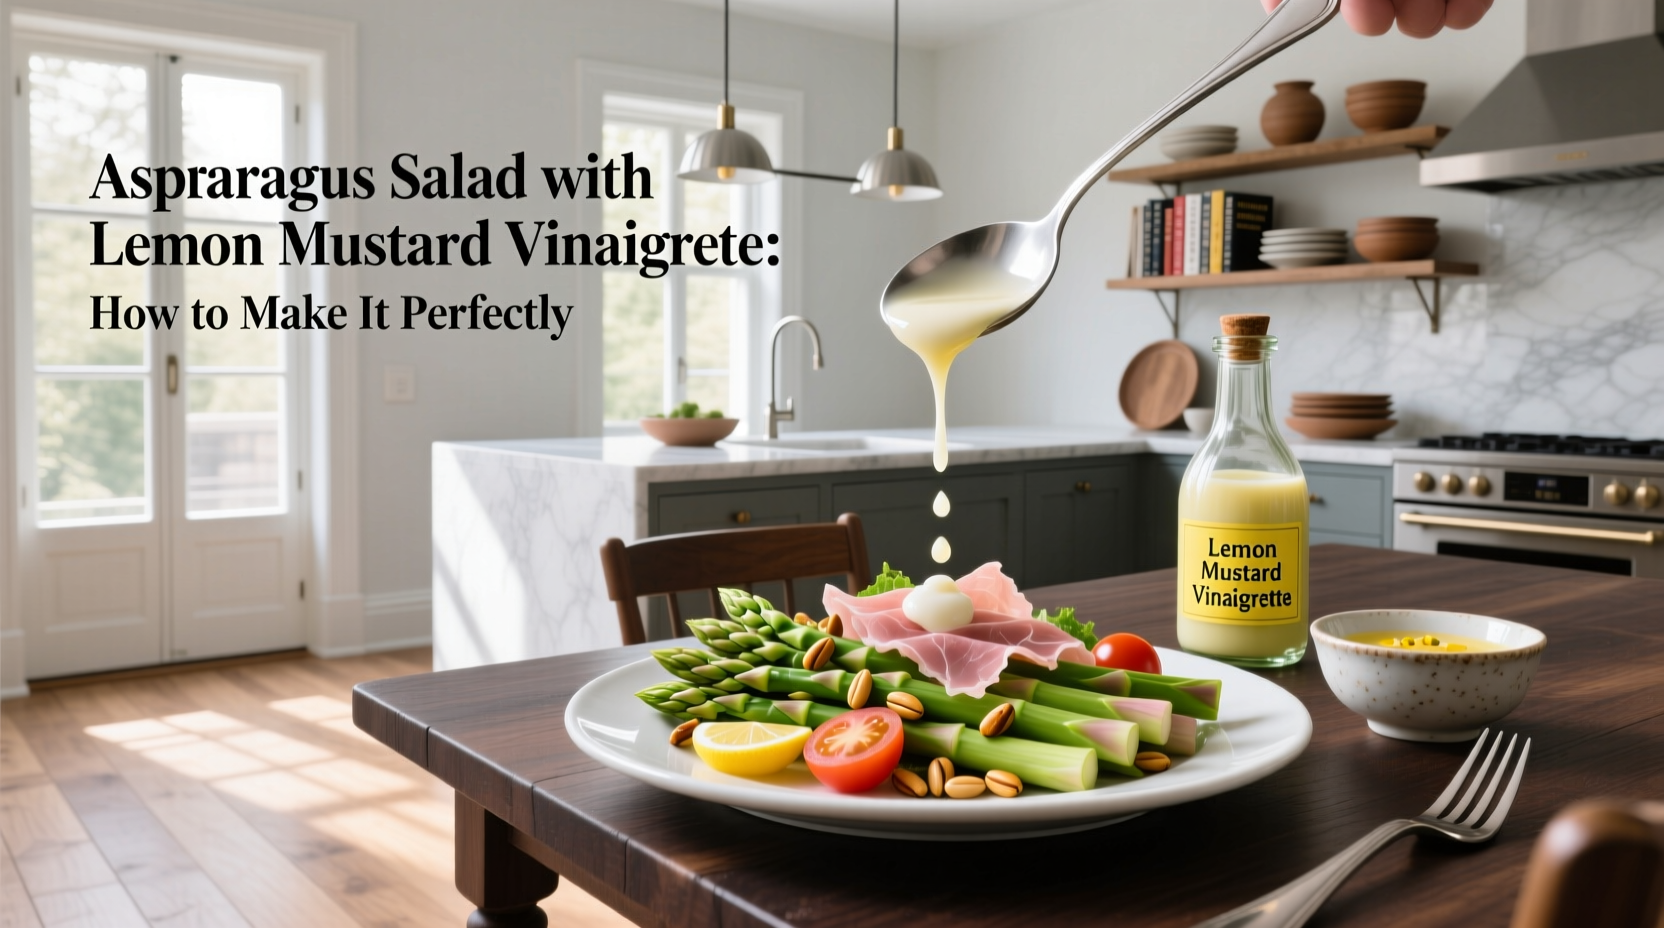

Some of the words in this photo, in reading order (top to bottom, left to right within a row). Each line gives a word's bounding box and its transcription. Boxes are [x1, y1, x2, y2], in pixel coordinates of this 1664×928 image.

[1208, 537, 1278, 559] Lemon
[1201, 560, 1282, 582] Mustard
[1192, 584, 1292, 613] Vinaigrette
